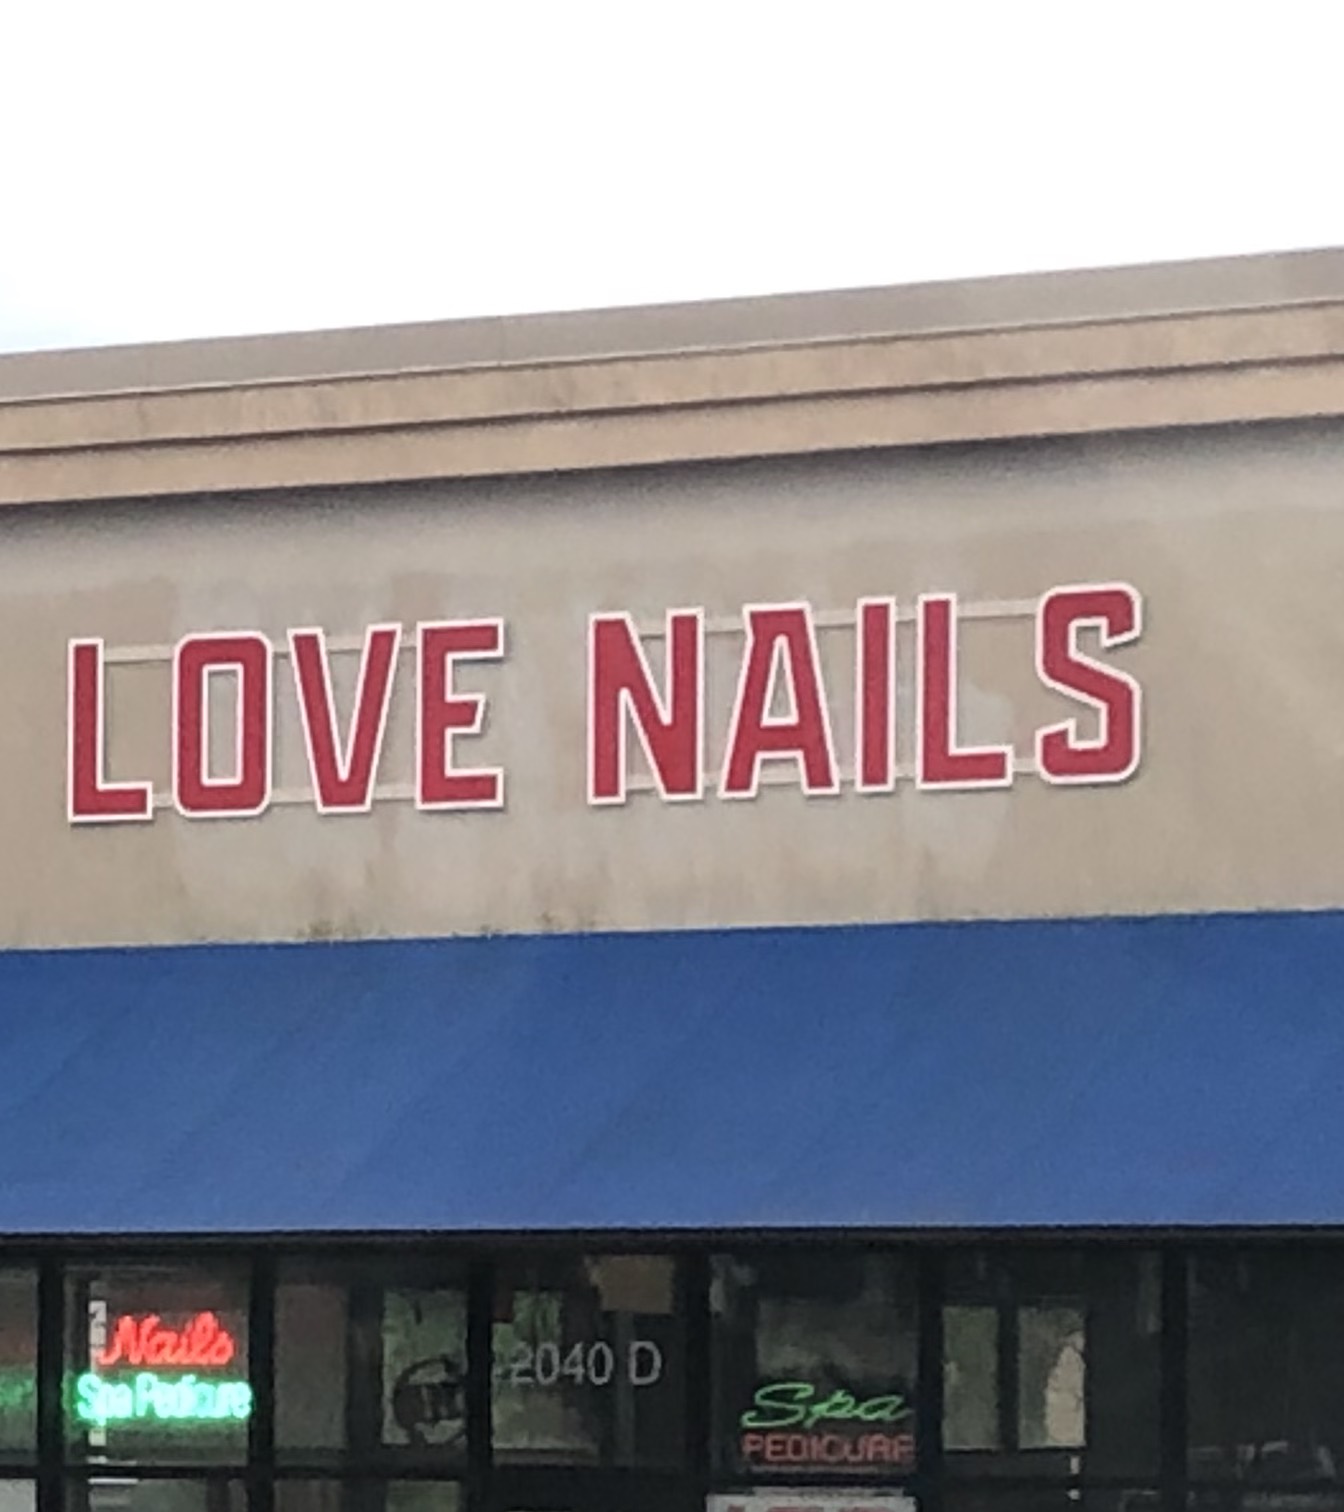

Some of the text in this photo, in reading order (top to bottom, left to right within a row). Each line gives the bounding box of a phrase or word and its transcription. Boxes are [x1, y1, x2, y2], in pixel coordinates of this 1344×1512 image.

[68, 583, 1143, 823] LOVE NAILS
[97, 1311, 234, 1365] Nails
[511, 1340, 662, 1386] 2040 D
[77, 1372, 133, 1426] Spa
[740, 1382, 914, 1428] Spa
